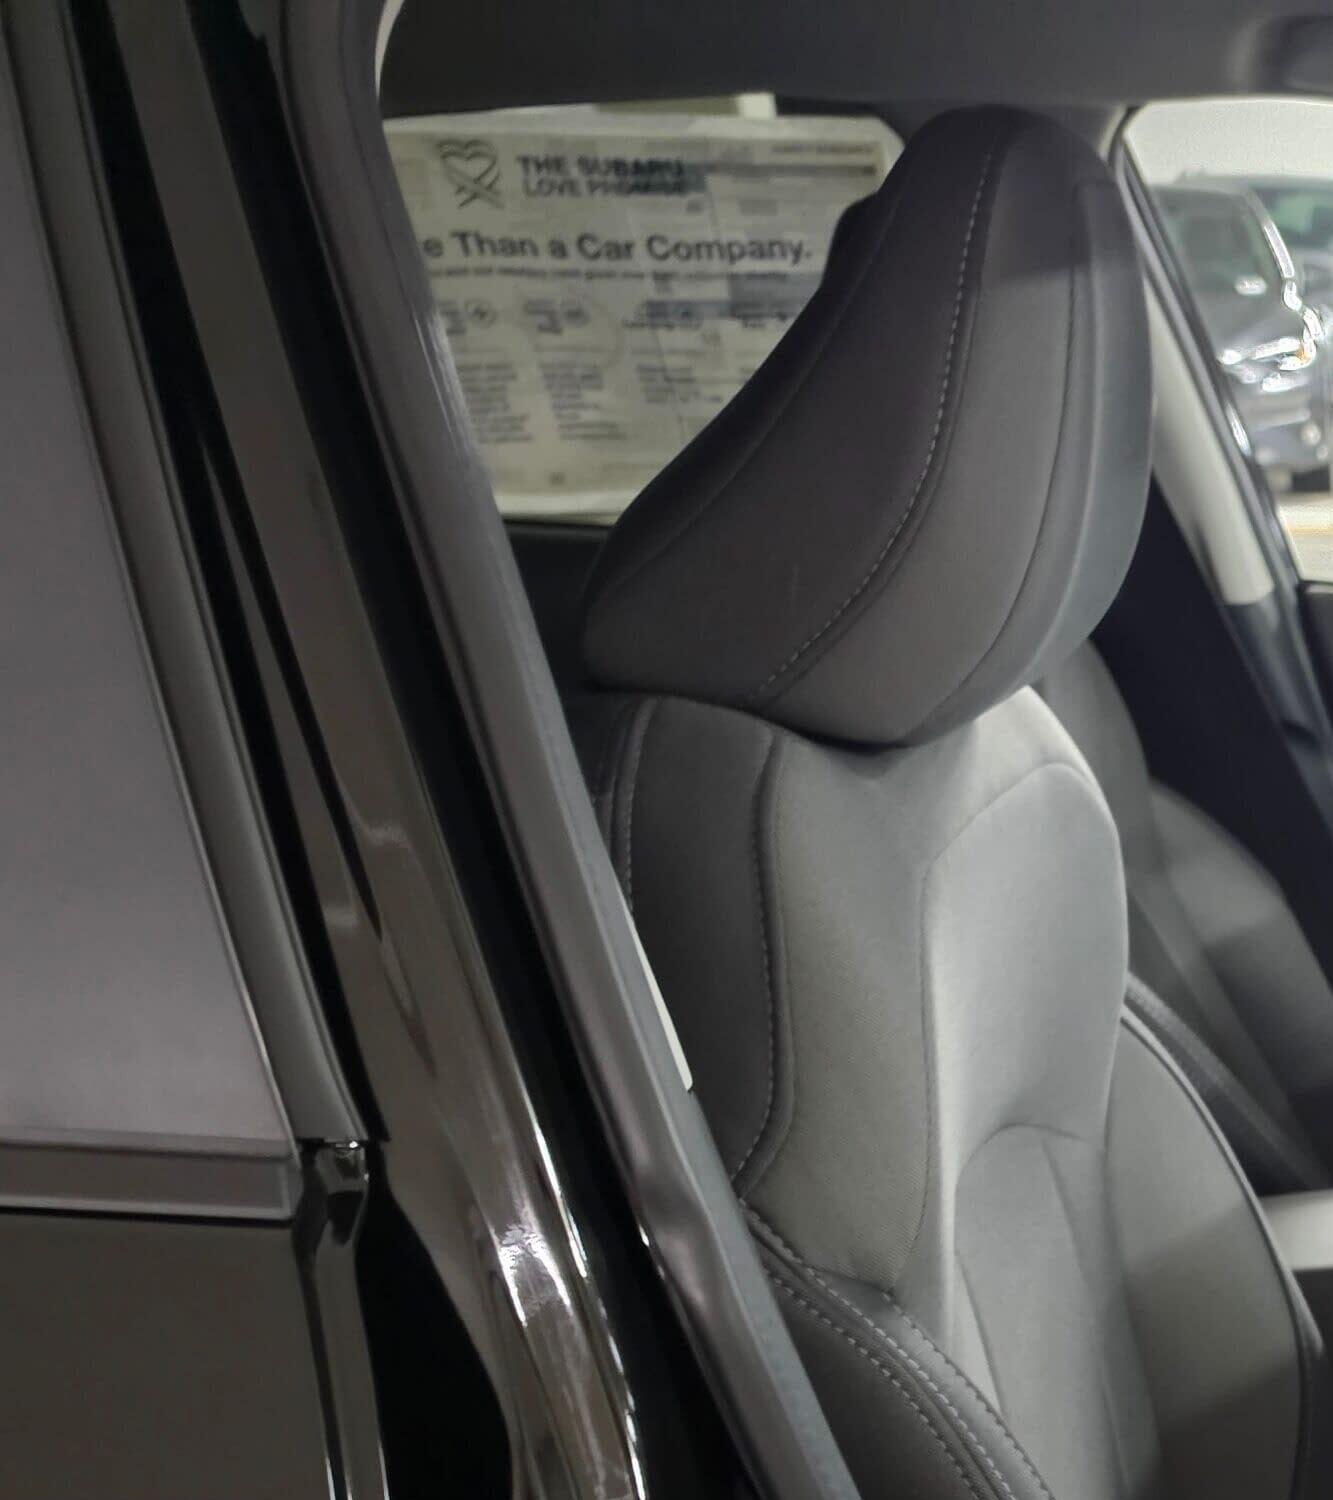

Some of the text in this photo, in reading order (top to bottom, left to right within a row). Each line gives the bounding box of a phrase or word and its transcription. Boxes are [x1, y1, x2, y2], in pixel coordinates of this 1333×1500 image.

[517, 155, 568, 175] THE
[450, 231, 540, 258] Than
[549, 239, 569, 259] a
[577, 233, 635, 261] Car
[647, 234, 812, 265] Company.
